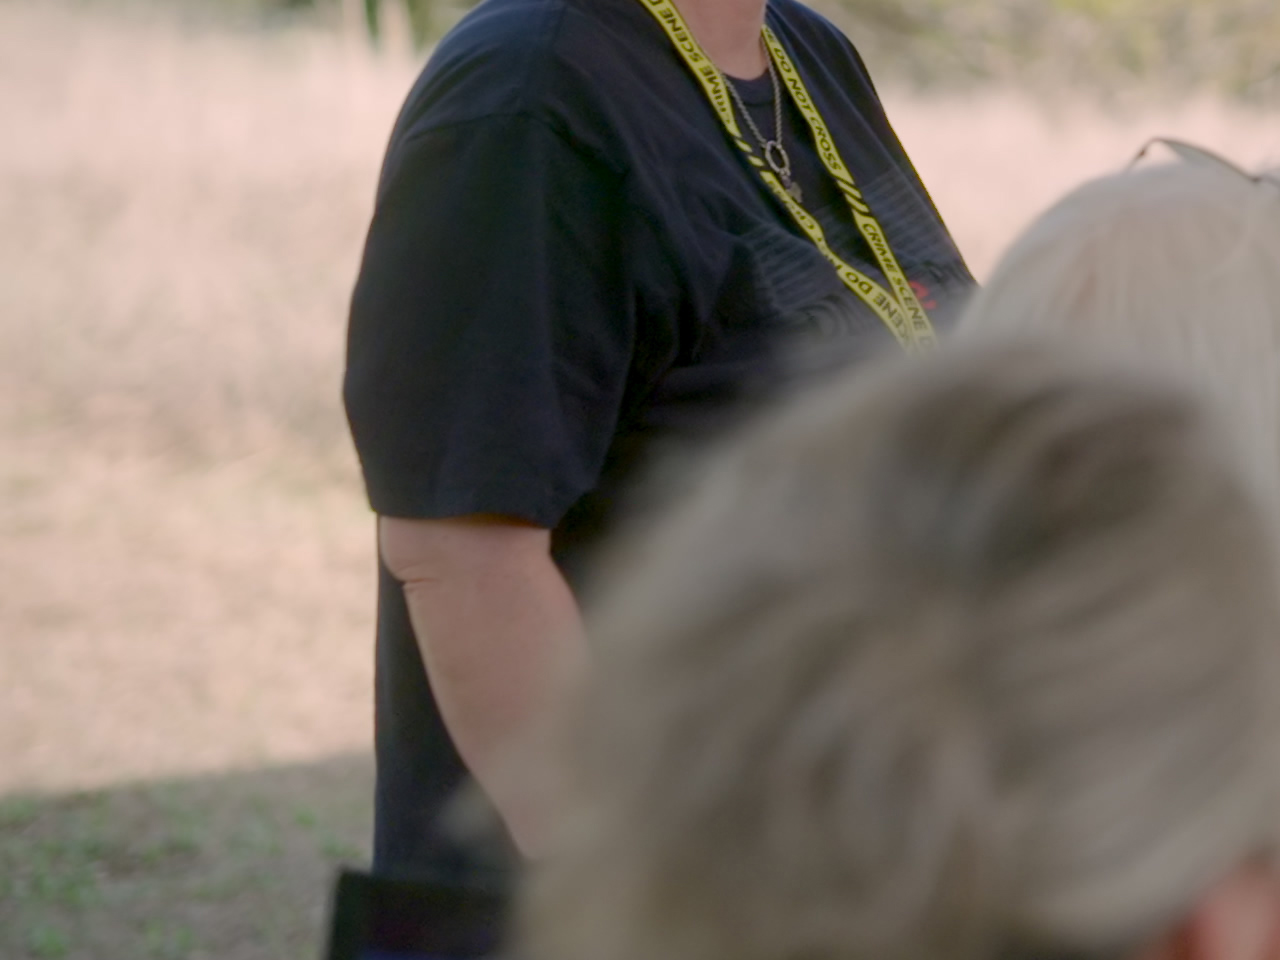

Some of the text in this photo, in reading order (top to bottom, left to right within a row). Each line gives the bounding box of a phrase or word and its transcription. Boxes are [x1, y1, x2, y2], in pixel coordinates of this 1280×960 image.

[660, 4, 702, 64] SCENE
[700, 64, 732, 125] CRIME
[773, 39, 843, 173] DO NOT CROSS
[844, 270, 873, 296] DO
[862, 222, 899, 273] CRIME
[892, 276, 929, 333] SCENE
